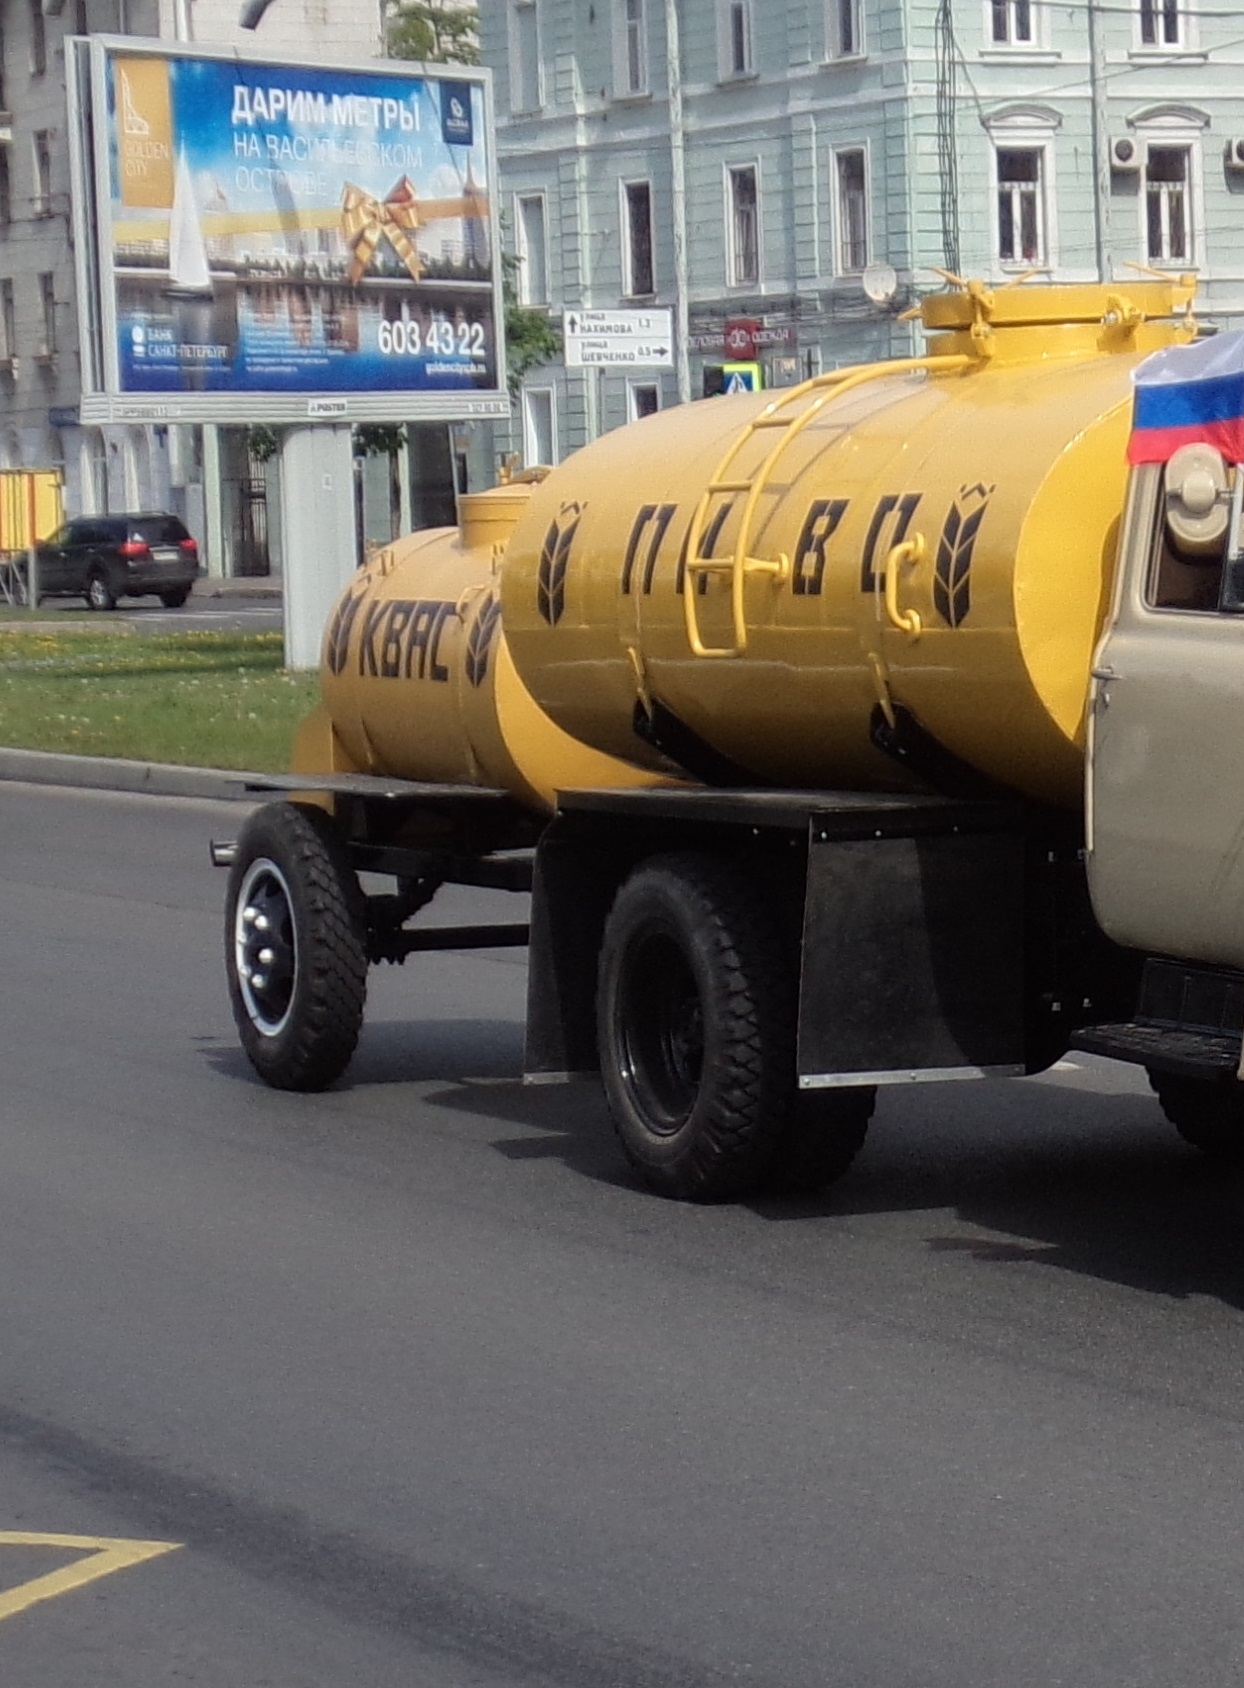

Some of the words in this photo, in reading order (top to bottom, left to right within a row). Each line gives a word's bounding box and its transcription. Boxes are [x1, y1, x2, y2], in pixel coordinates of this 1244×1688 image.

[231, 84, 326, 125] ДАРИМ
[331, 93, 421, 131] МЕТРЫ
[124, 139, 169, 159] GOLDEN
[232, 131, 261, 158] НА
[147, 328, 174, 341] БАНК
[378, 319, 421, 355] 603
[425, 320, 454, 355] 43
[457, 321, 486, 356] 22
[580, 324, 633, 334] НАХИМОВА
[147, 344, 229, 358] САНКТ-ПЕТЕРБУРГ
[581, 352, 636, 362] ШЕВЧЕНКО
[358, 599, 469, 682] КВАС
